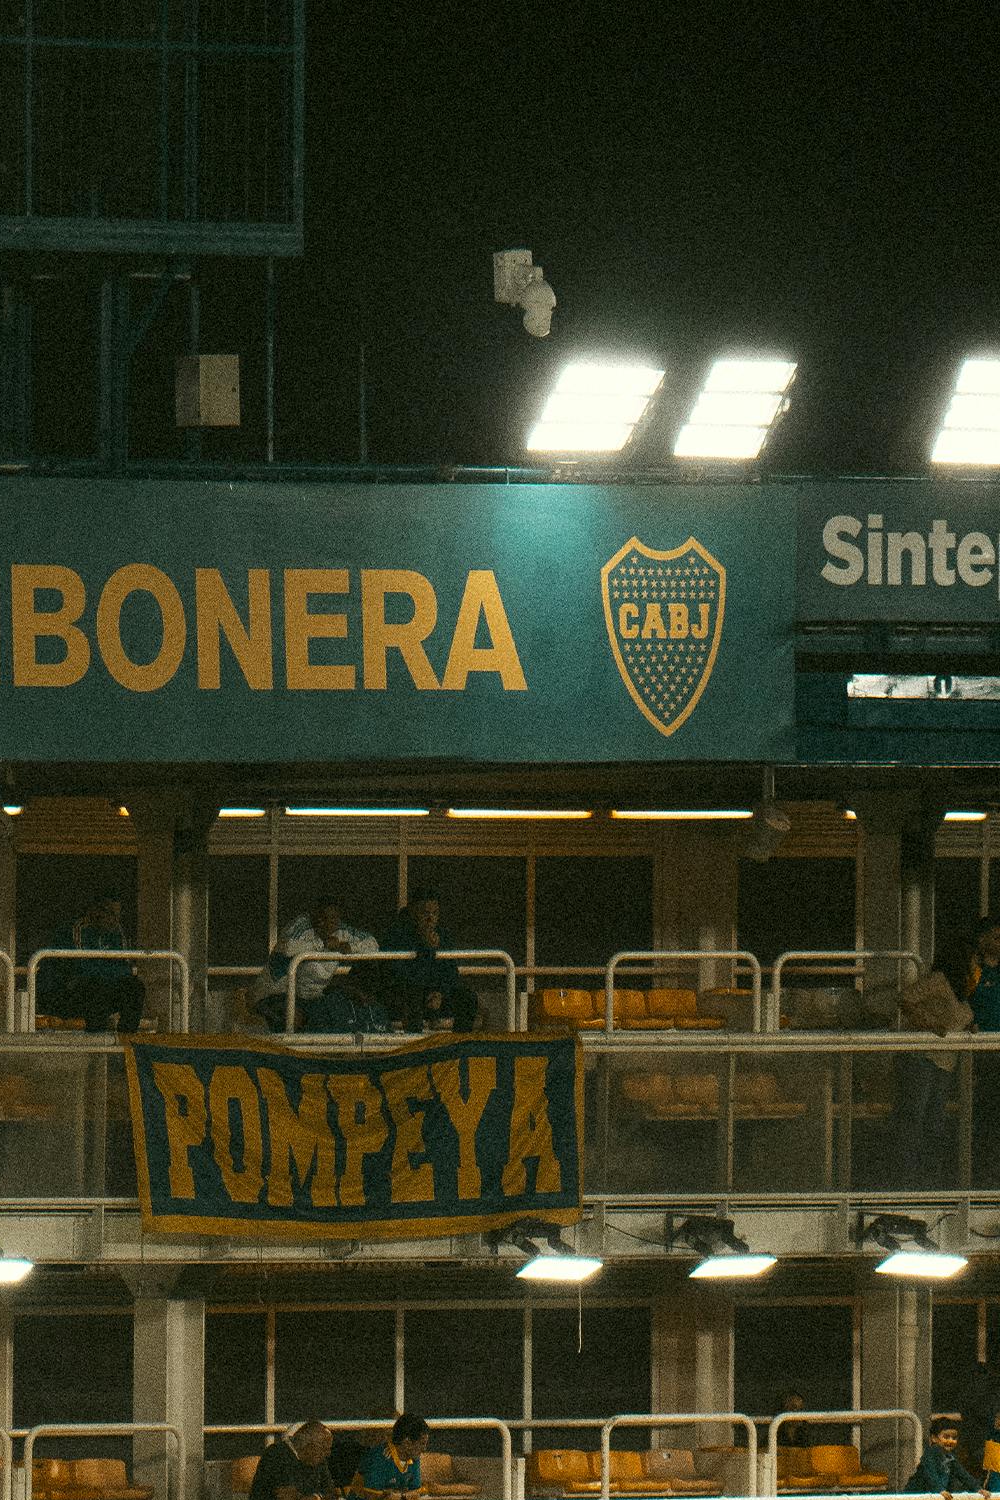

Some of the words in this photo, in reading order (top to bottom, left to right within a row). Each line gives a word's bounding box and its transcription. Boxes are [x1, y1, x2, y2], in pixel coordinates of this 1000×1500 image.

[820, 514, 1000, 590] Sinte
[619, 602, 710, 640] CABJ
[153, 1056, 562, 1207] POMPEYA
